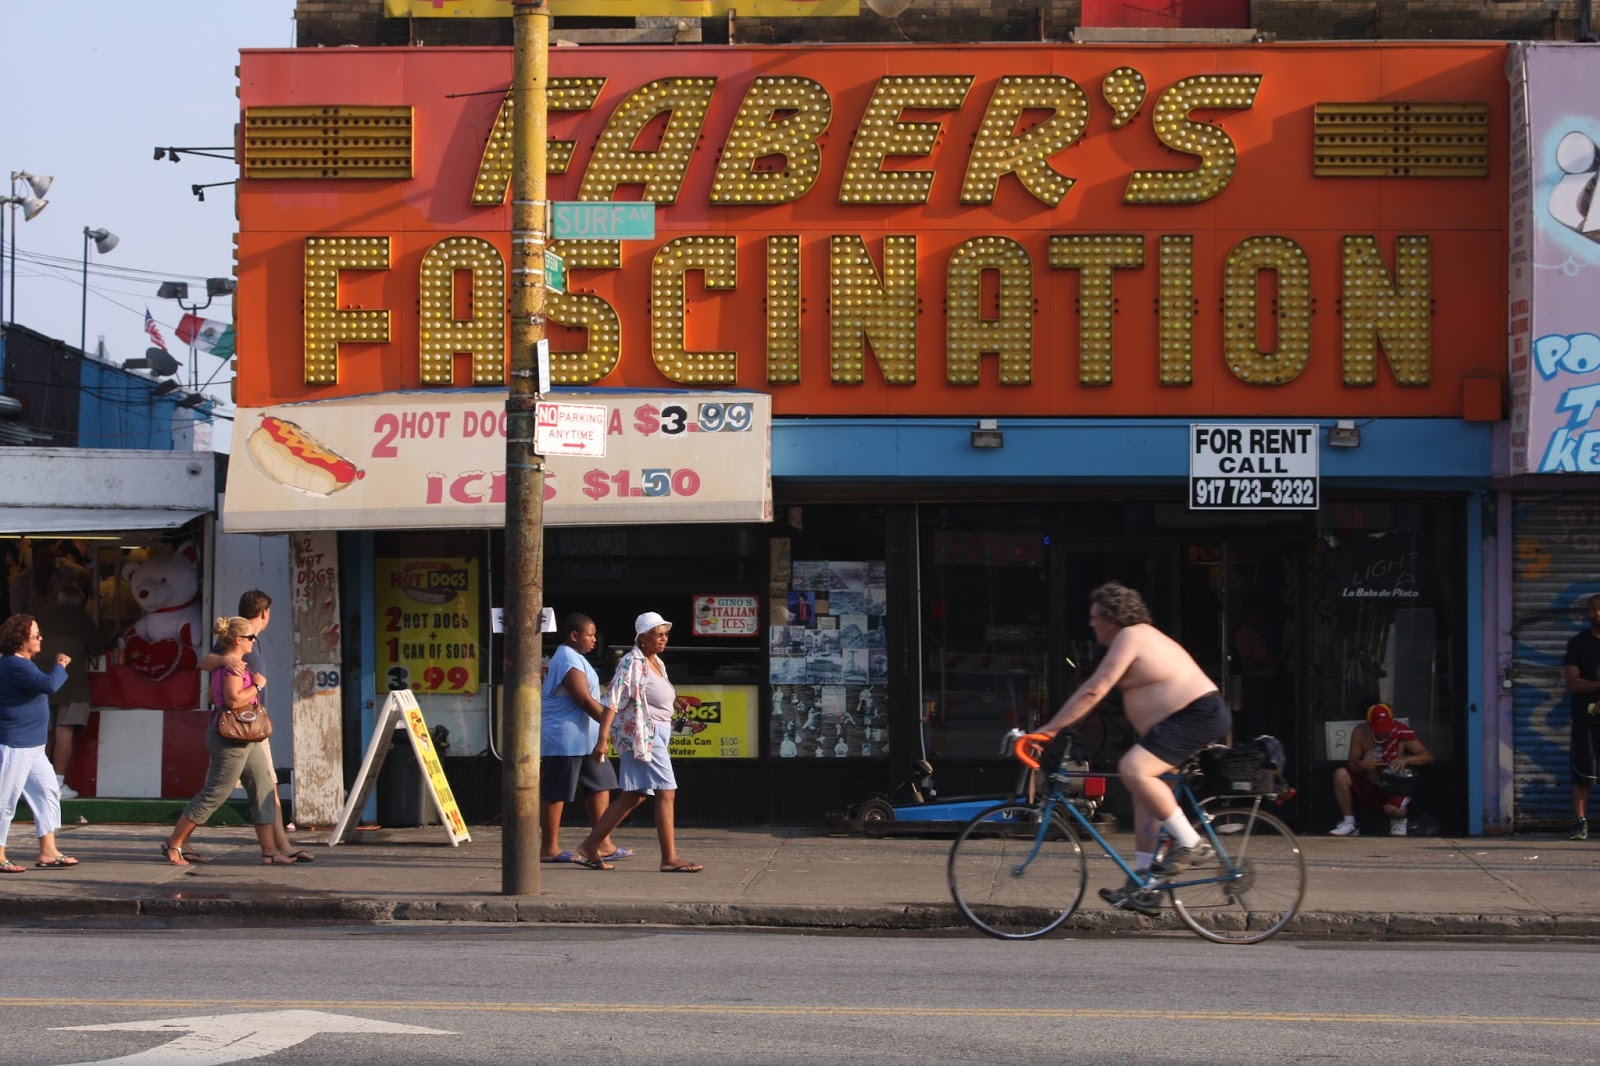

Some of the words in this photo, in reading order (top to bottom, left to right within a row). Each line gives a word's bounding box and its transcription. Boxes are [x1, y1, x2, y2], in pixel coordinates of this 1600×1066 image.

[470, 66, 1264, 207] FABER'S
[556, 206, 625, 235] SURF
[628, 207, 650, 222] AV
[545, 253, 559, 273] ERSON
[304, 234, 1432, 387] FASCINATION
[1533, 332, 1600, 381] PO
[538, 406, 557, 424] NO
[559, 412, 603, 424] PARKING
[371, 413, 400, 458] 2
[400, 411, 450, 439] HOT
[633, 403, 753, 437] $3.99
[548, 430, 594, 441] ANYTIME
[1195, 428, 1242, 454] FOR
[1250, 429, 1312, 454] RENT
[1537, 427, 1600, 473] KE
[1218, 456, 1288, 474] CALL
[582, 468, 701, 501] $1.50
[1196, 479, 1225, 504] 917
[1230, 479, 1314, 504] 723-3232
[390, 572, 424, 588] HOT
[429, 571, 468, 587] DOGS
[1342, 587, 1355, 597] La
[1378, 589, 1391, 597] de
[1392, 588, 1419, 597] Plata
[712, 607, 755, 617] ITALIAN
[718, 599, 752, 607] GINO'S
[386, 606, 402, 632] 2
[403, 613, 428, 628] HOT
[434, 613, 469, 628] DOGS
[722, 619, 745, 629] ICES
[386, 637, 399, 662] 1
[403, 643, 424, 659] CAN
[429, 643, 441, 659] OF
[446, 643, 475, 659] SODA
[387, 666, 469, 691] 3.99
[669, 738, 691, 746] Soda
[694, 738, 711, 746] Can
[670, 748, 696, 756] Water
